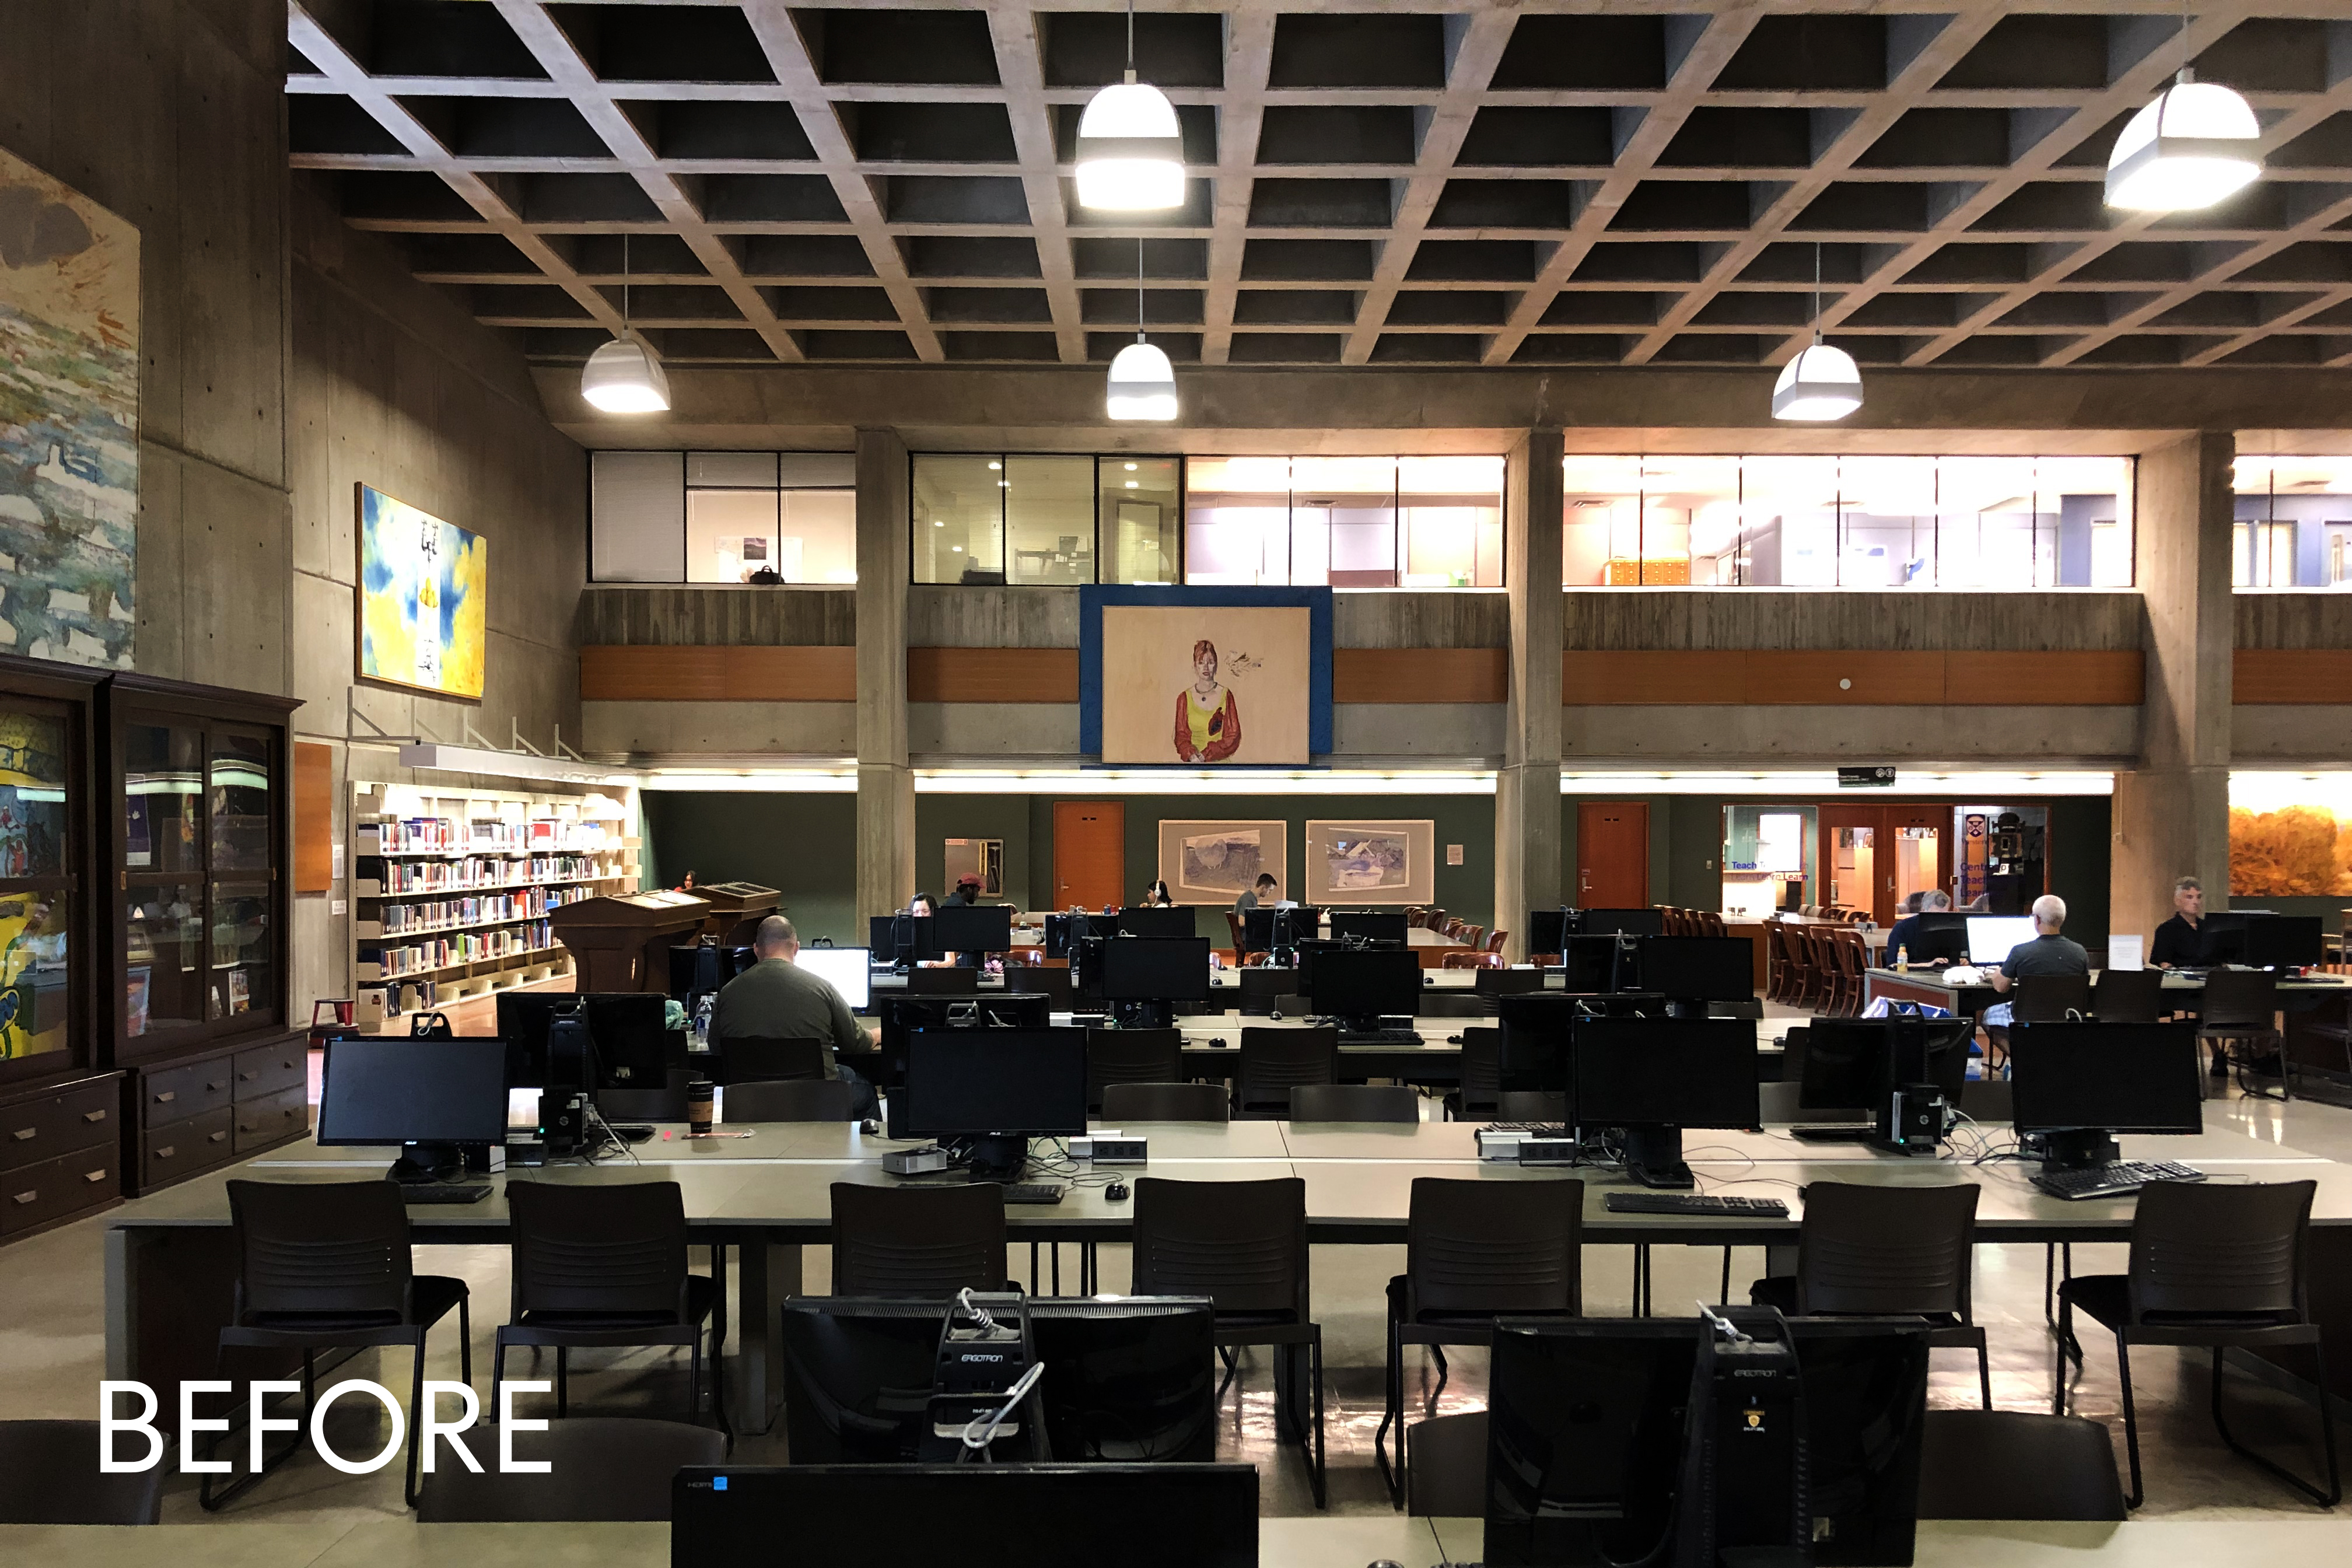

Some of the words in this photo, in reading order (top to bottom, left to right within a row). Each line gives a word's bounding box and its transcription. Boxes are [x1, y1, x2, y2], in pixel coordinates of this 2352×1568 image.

[1731, 861, 1757, 869] Teach
[1783, 873, 1808, 881] Learn
[961, 1354, 1003, 1362] ERGOTRON
